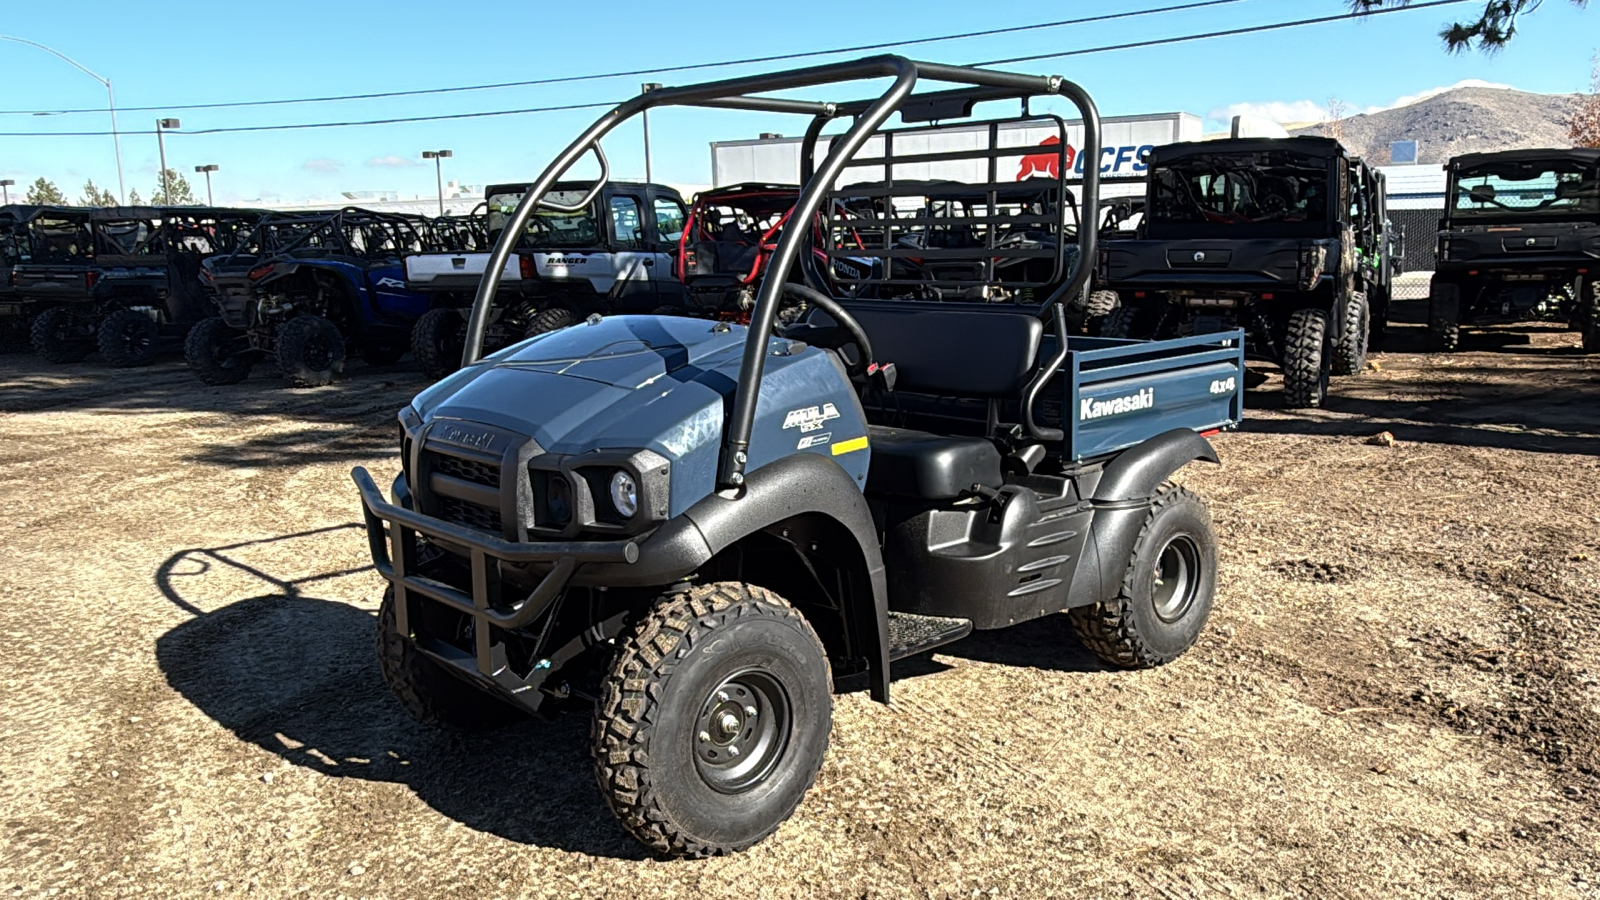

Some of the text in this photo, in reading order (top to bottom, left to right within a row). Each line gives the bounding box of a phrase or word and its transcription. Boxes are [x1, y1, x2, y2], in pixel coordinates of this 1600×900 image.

[833, 259, 861, 279] HONDA
[1210, 377, 1235, 394] 4x4
[1080, 387, 1154, 420] Kawasaki
